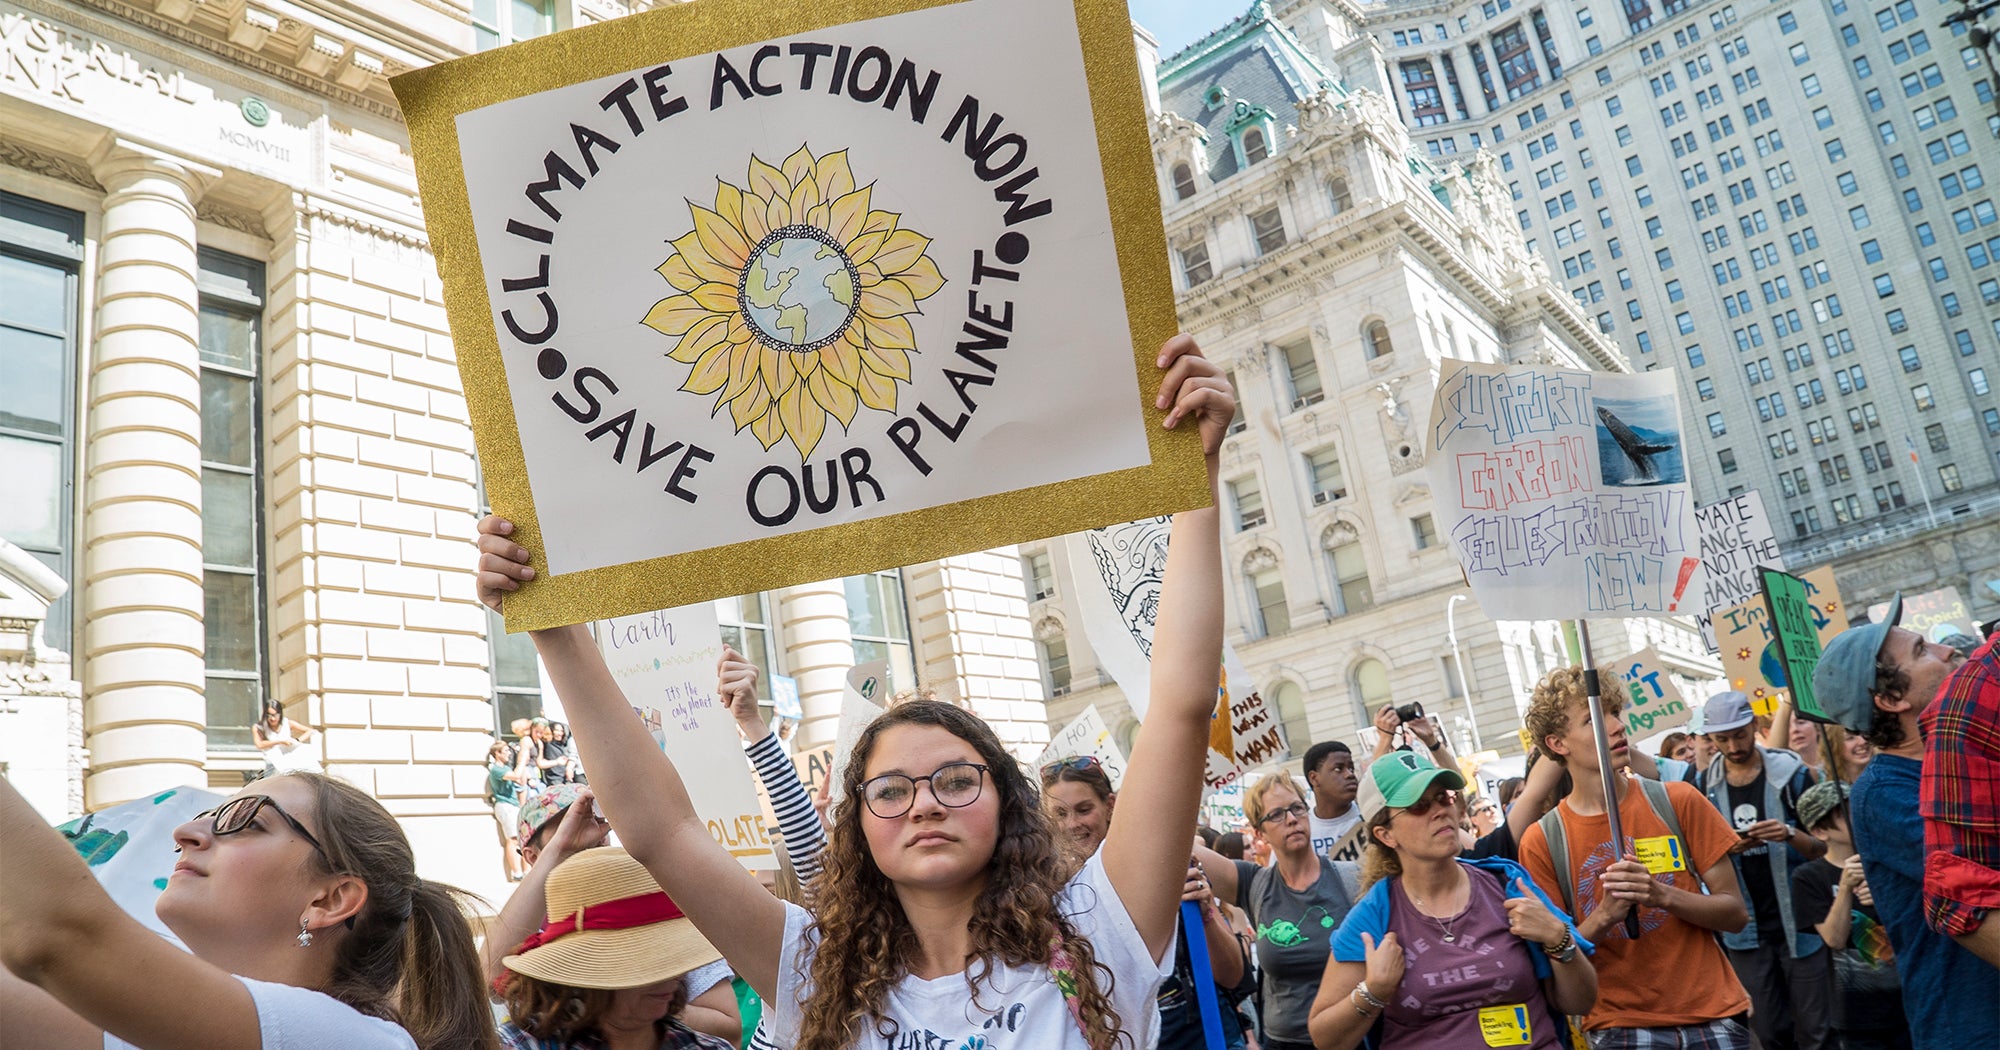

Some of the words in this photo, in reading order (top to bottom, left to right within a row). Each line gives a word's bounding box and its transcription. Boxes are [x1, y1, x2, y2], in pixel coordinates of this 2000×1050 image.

[219, 126, 291, 163] MCMVIII
[502, 65, 689, 345] CLIMATE
[709, 42, 942, 124] ACTION
[941, 95, 1053, 227] NOW
[552, 366, 715, 503] SAVE
[746, 447, 885, 527] OUR
[886, 250, 1021, 476] PLANET
[1436, 365, 1592, 451] SUPPORT
[1456, 436, 1593, 511] CARBON
[1451, 490, 1685, 580] SEQUESTRATION
[1702, 549, 1738, 579] NOT
[1741, 536, 1780, 565] THE
[608, 609, 677, 649] Earth
[1722, 606, 1765, 635] I'm
[684, 681, 698, 696] the
[688, 693, 713, 714] planet
[1231, 691, 1263, 717] THIS
[1066, 714, 1094, 746] HOT
[1235, 724, 1285, 766] WANT
[1422, 964, 1481, 987] THE
